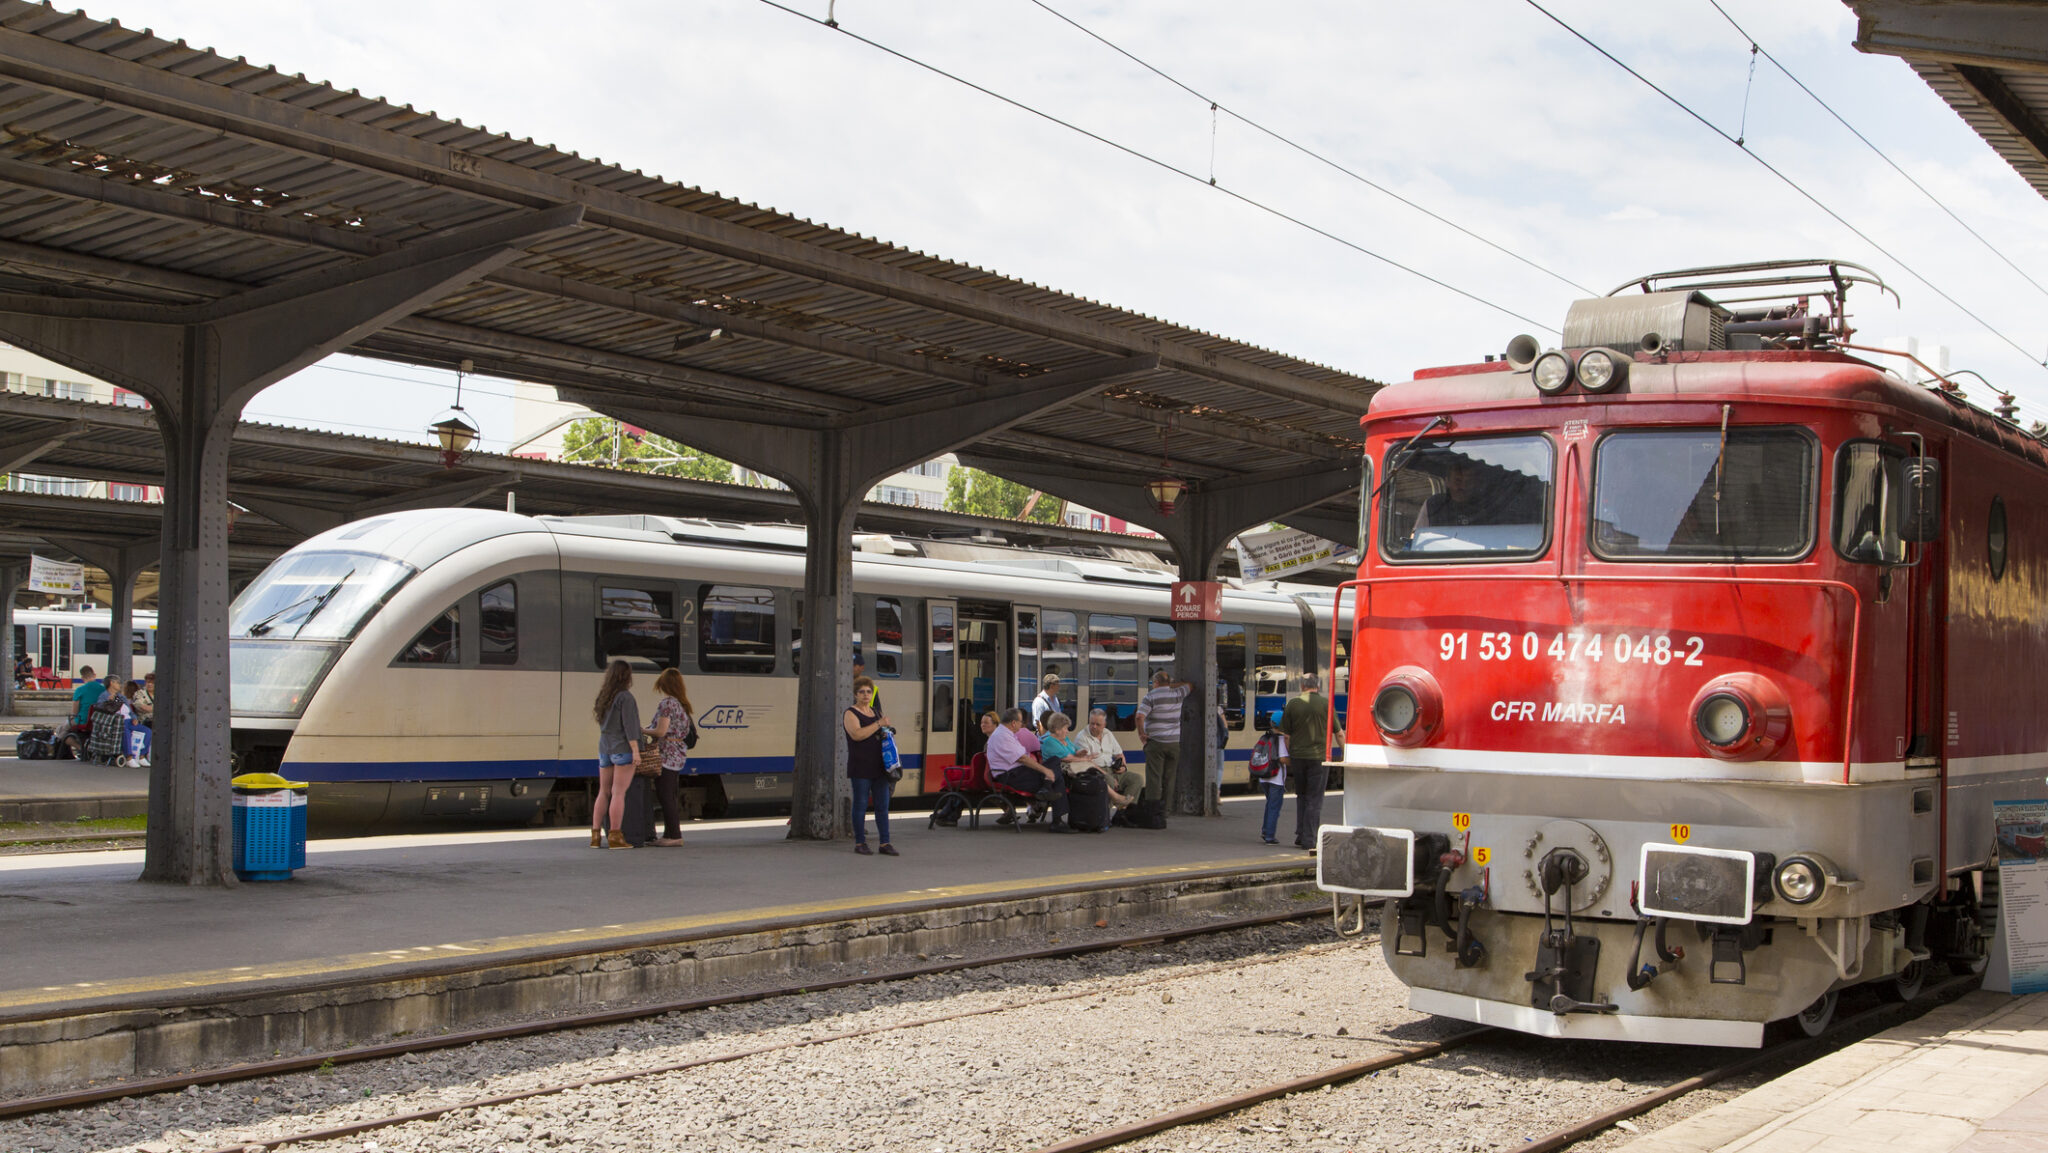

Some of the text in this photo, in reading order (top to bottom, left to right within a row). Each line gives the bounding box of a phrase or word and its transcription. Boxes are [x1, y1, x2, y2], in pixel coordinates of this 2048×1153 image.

[1282, 559, 1297, 568] TAXI
[683, 599, 695, 624] 2
[1175, 604, 1201, 612] ZONARE
[1439, 631, 1705, 667] 91 53 0 474 048-2
[716, 709, 744, 724] CFR
[1490, 701, 1626, 724] CFR MARFA
[1453, 814, 1470, 827] 10
[1671, 824, 1688, 839] 10
[1477, 848, 1486, 862] 5
